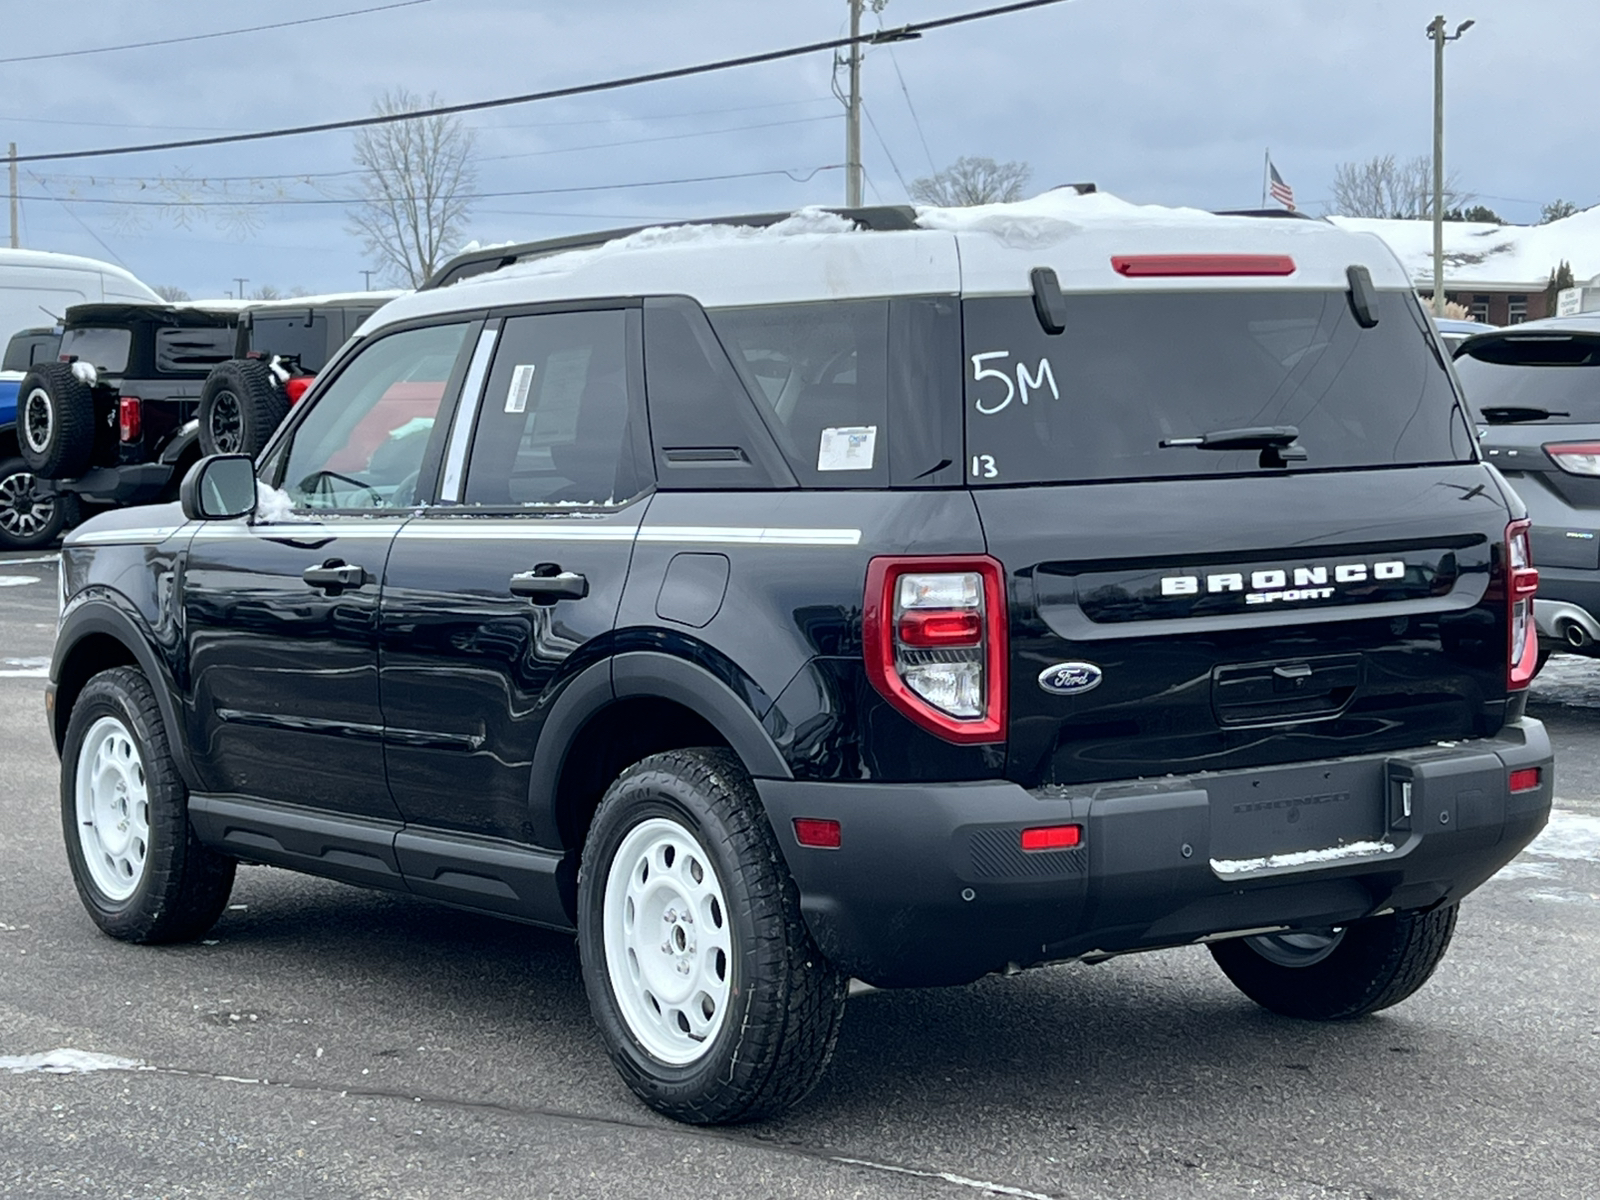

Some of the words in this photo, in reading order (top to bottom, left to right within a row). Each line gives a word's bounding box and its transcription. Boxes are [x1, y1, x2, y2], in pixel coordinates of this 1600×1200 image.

[971, 350, 1059, 415] 5M
[972, 454, 998, 478] 13
[1161, 561, 1405, 596] BRONCO
[1245, 587, 1336, 605] SPORT
